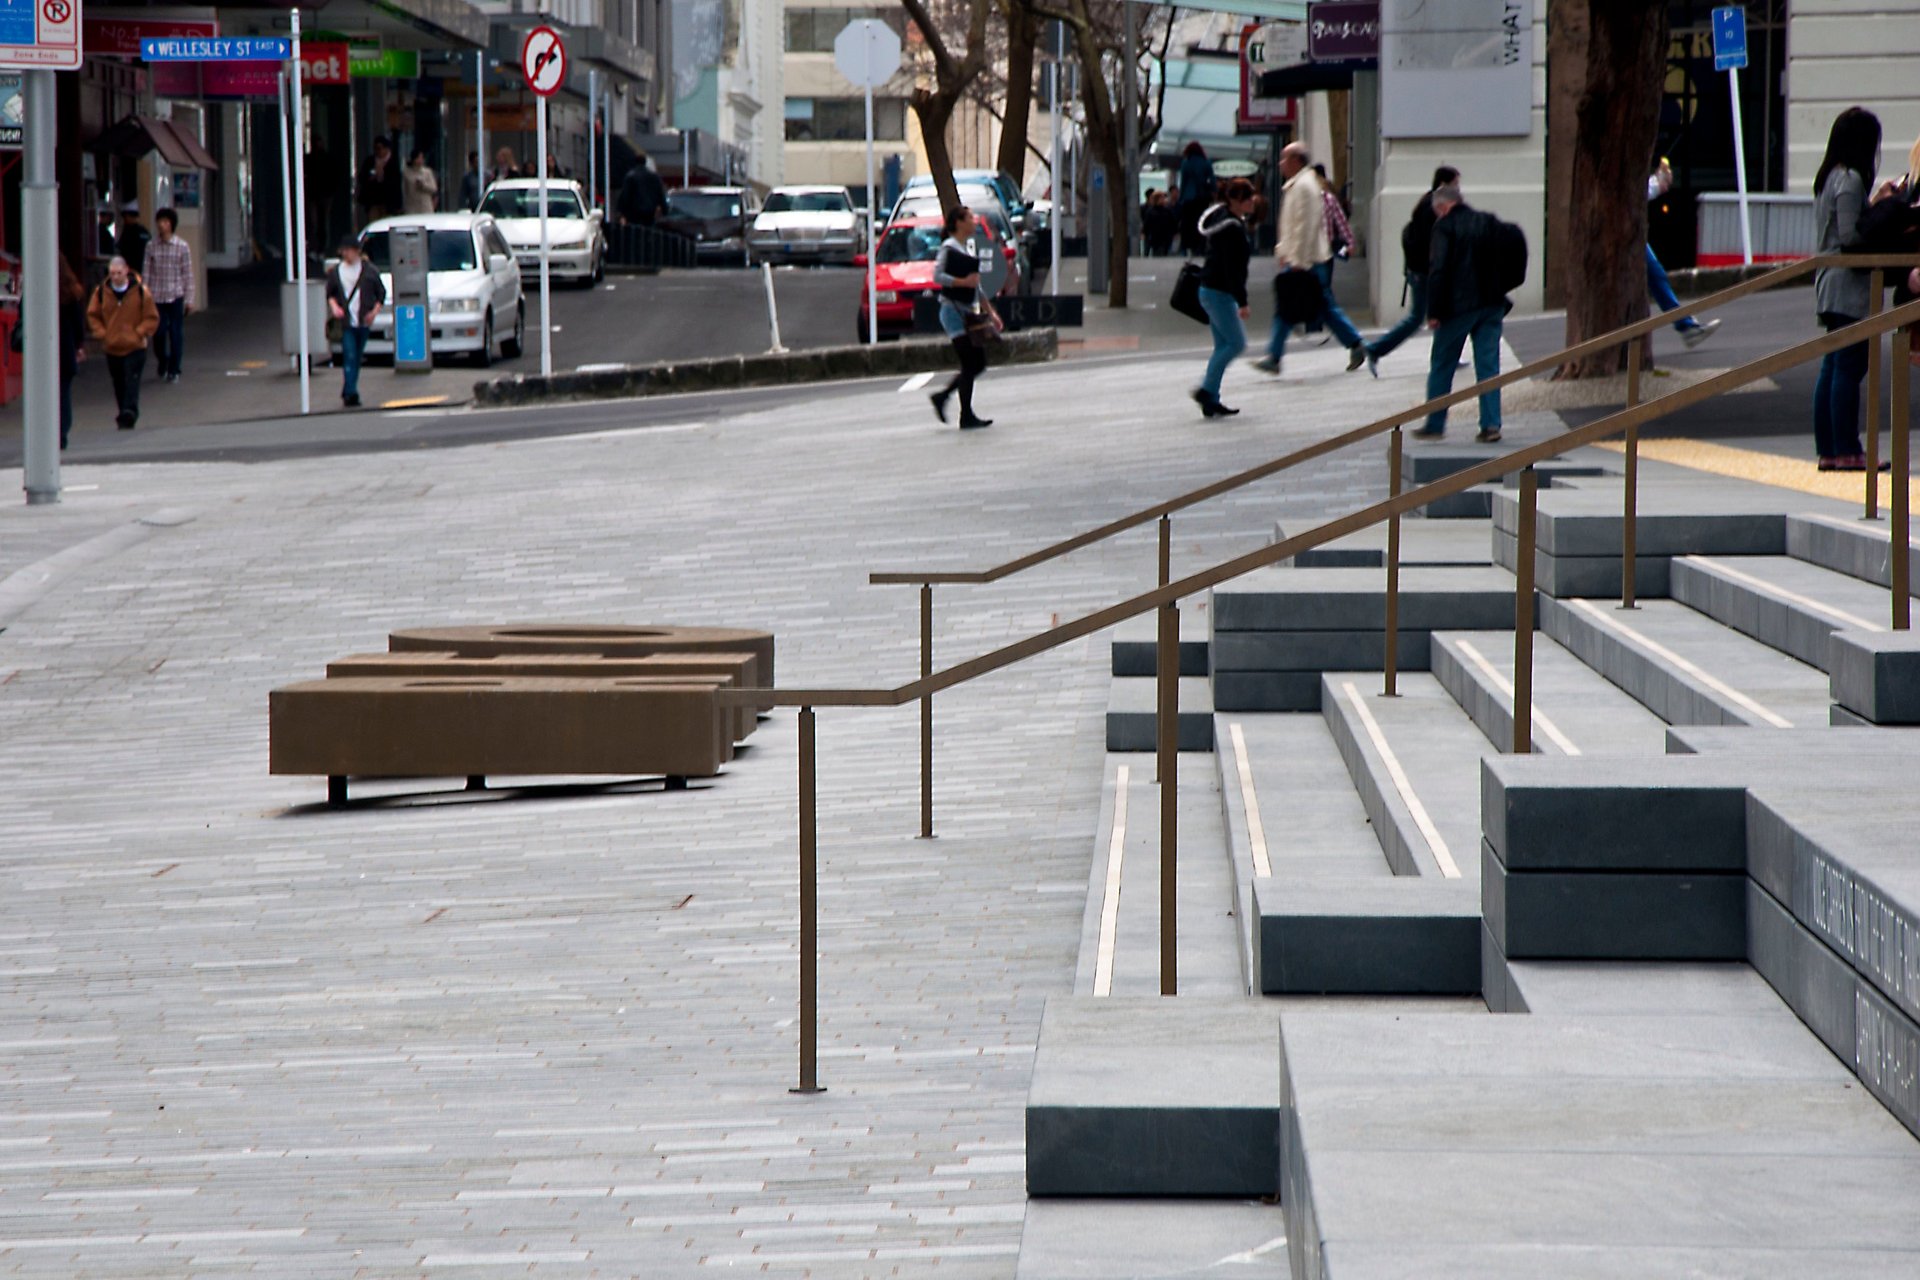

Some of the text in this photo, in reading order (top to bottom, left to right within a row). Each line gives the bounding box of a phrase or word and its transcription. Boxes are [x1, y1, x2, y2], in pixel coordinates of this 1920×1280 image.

[158, 41, 232, 57] WELLESLEY
[237, 41, 252, 56] ST
[255, 41, 275, 51] EAST
[1501, 1, 1522, 66] WHAT
